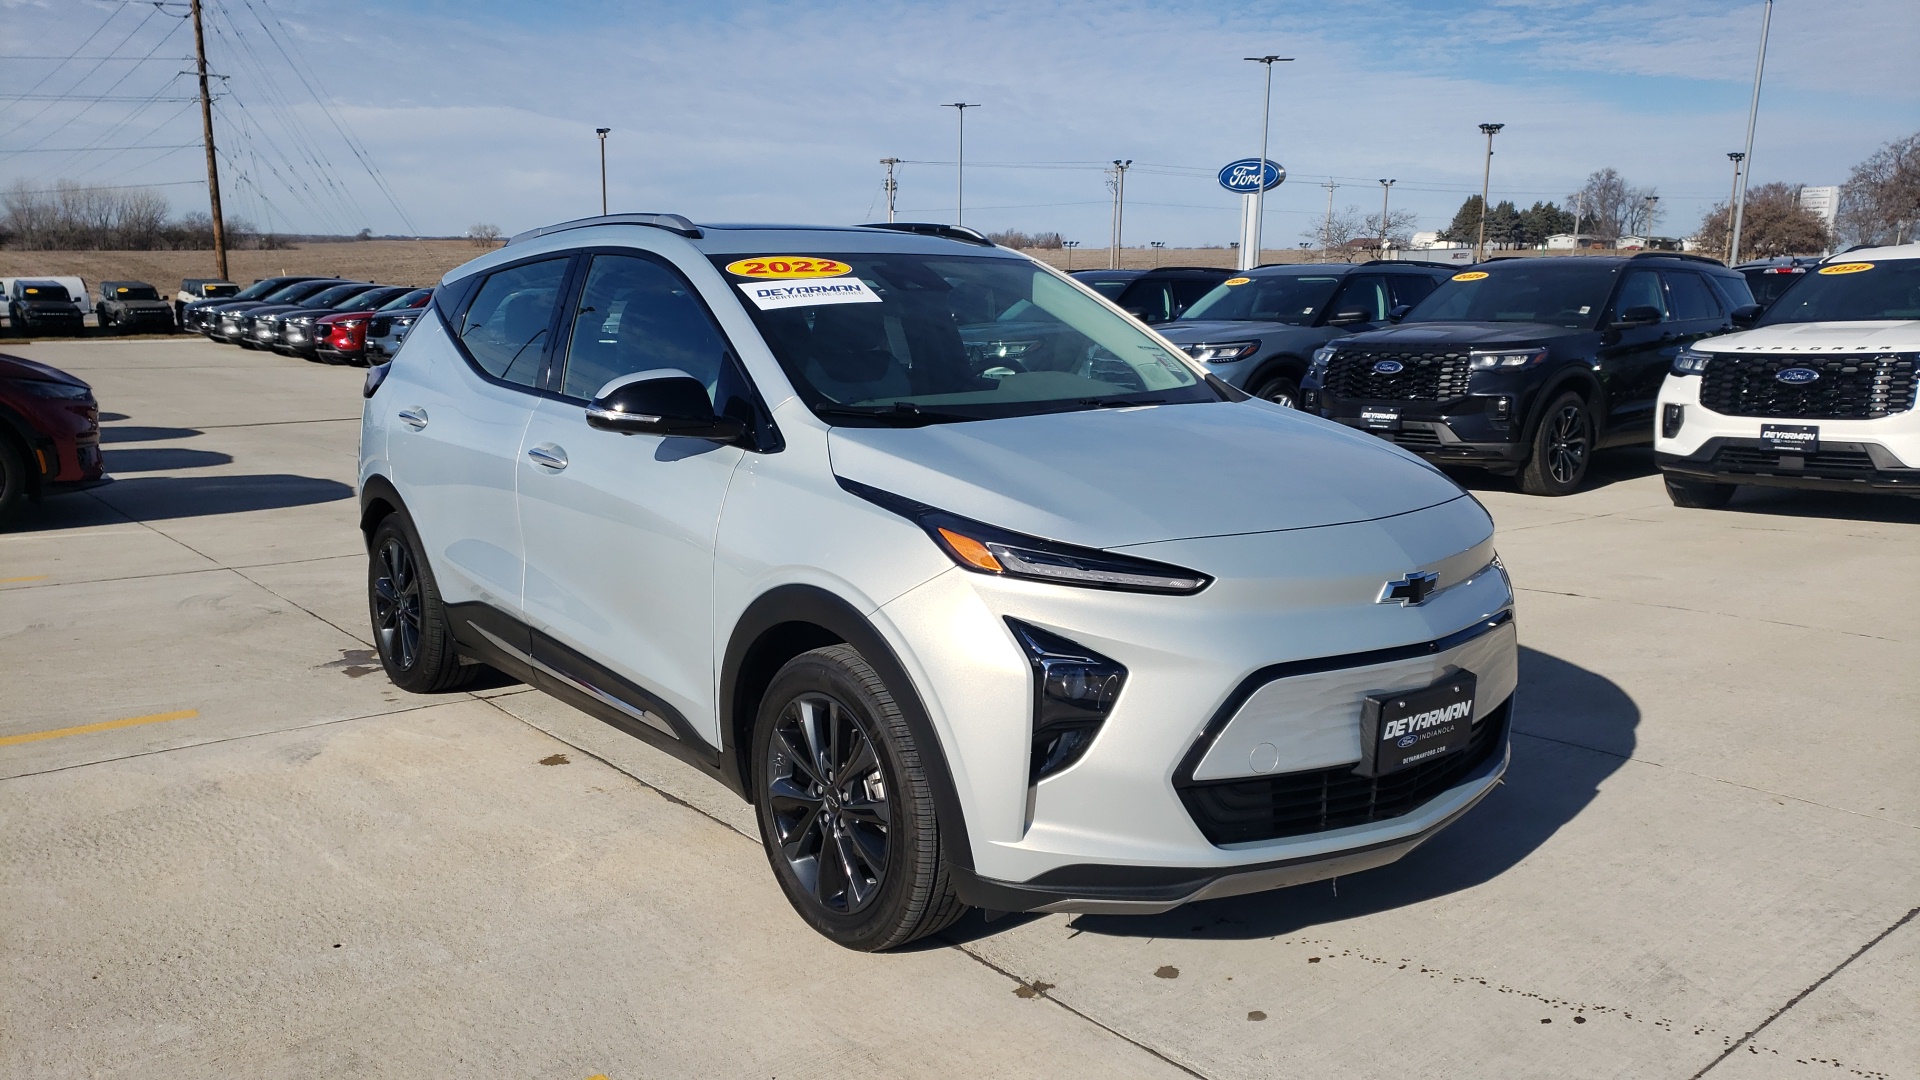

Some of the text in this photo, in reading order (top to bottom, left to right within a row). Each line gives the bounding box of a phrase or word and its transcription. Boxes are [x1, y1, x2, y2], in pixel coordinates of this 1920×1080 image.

[744, 260, 841, 275] 2022
[756, 284, 861, 298] DEYARMAN
[769, 293, 814, 301] CERTIFIED
[1361, 412, 1398, 420] DEYARMAN
[1762, 430, 1816, 441] DEYARMAN
[1383, 700, 1472, 740] DEYARMAN
[1419, 724, 1455, 741] INDIANOLA
